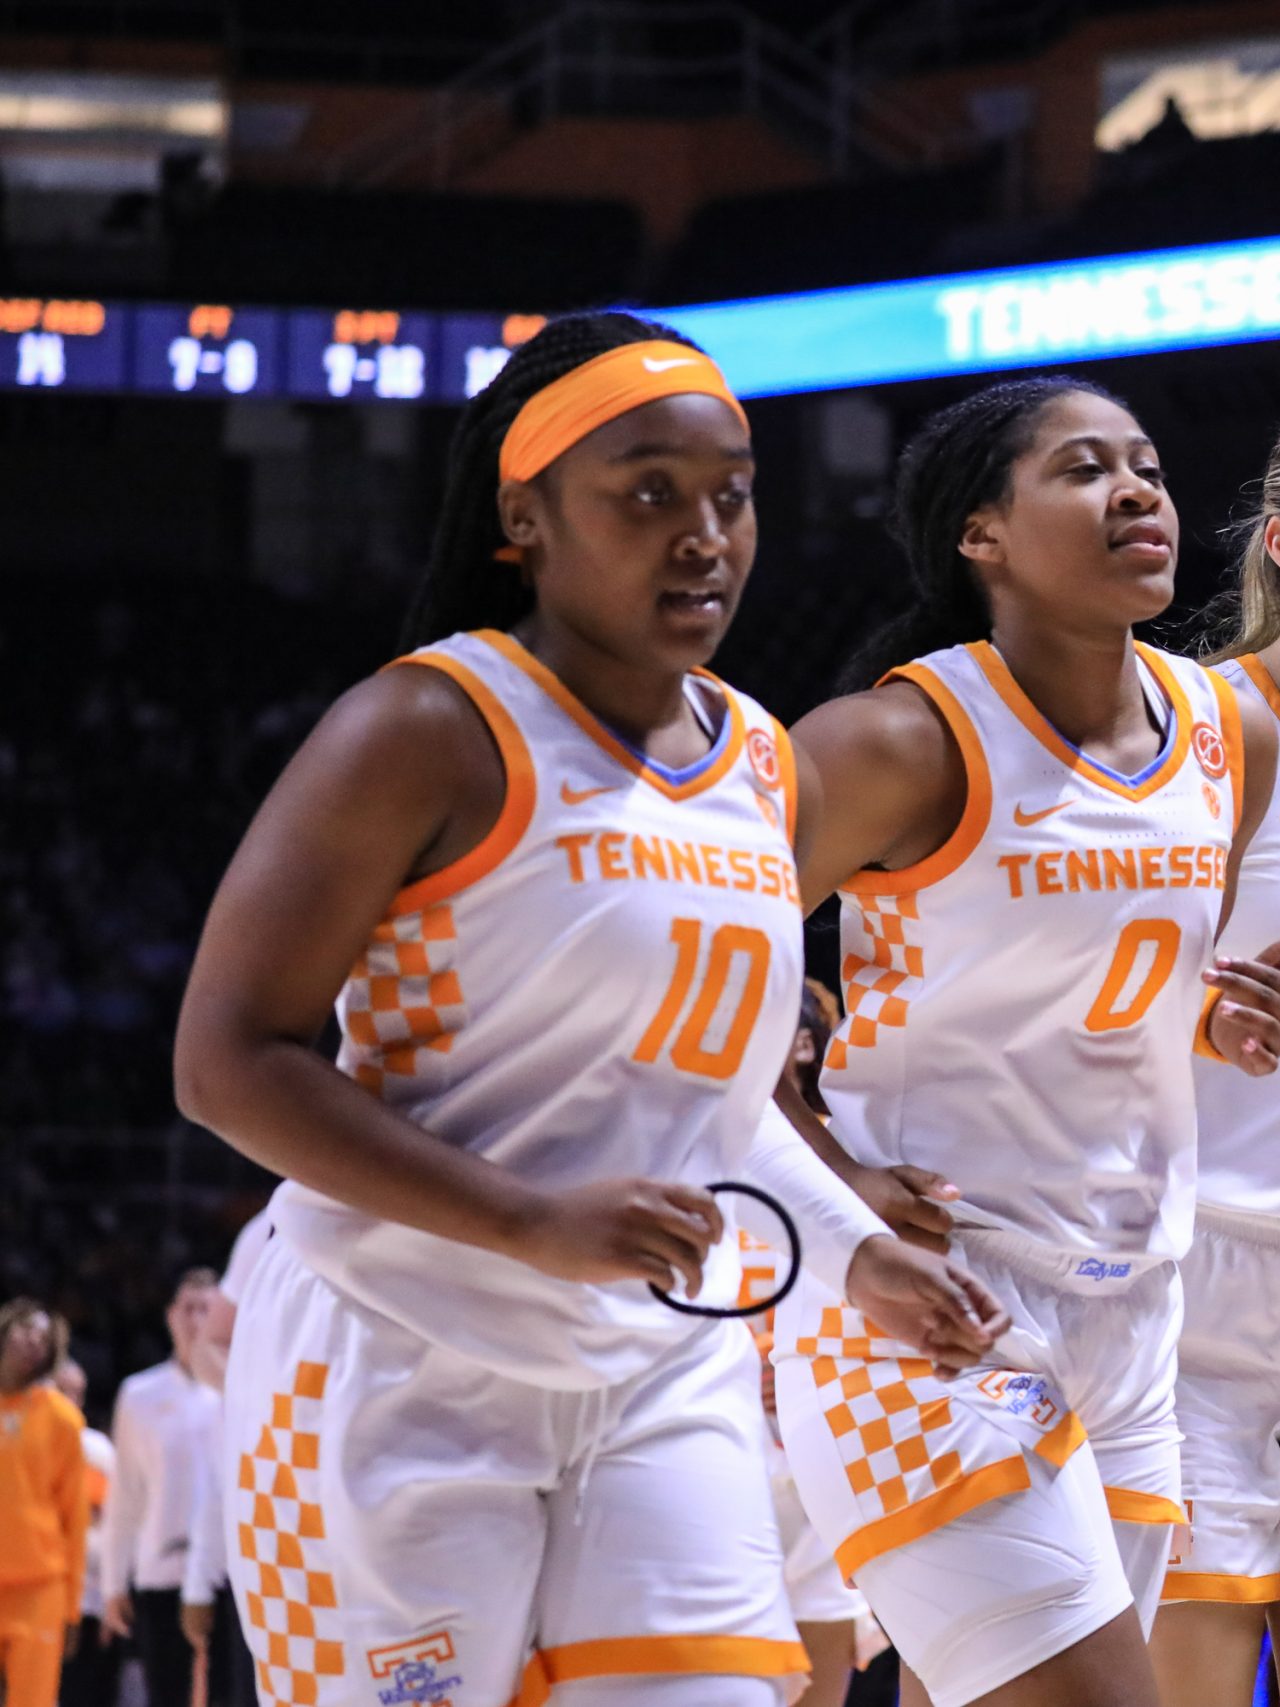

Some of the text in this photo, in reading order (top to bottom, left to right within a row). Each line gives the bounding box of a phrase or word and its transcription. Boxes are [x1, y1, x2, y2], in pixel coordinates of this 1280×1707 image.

[555, 833, 803, 907] TENNESSE
[997, 846, 1227, 899] TENNESSE
[631, 916, 771, 1080] 10
[1084, 918, 1182, 1032] 0
